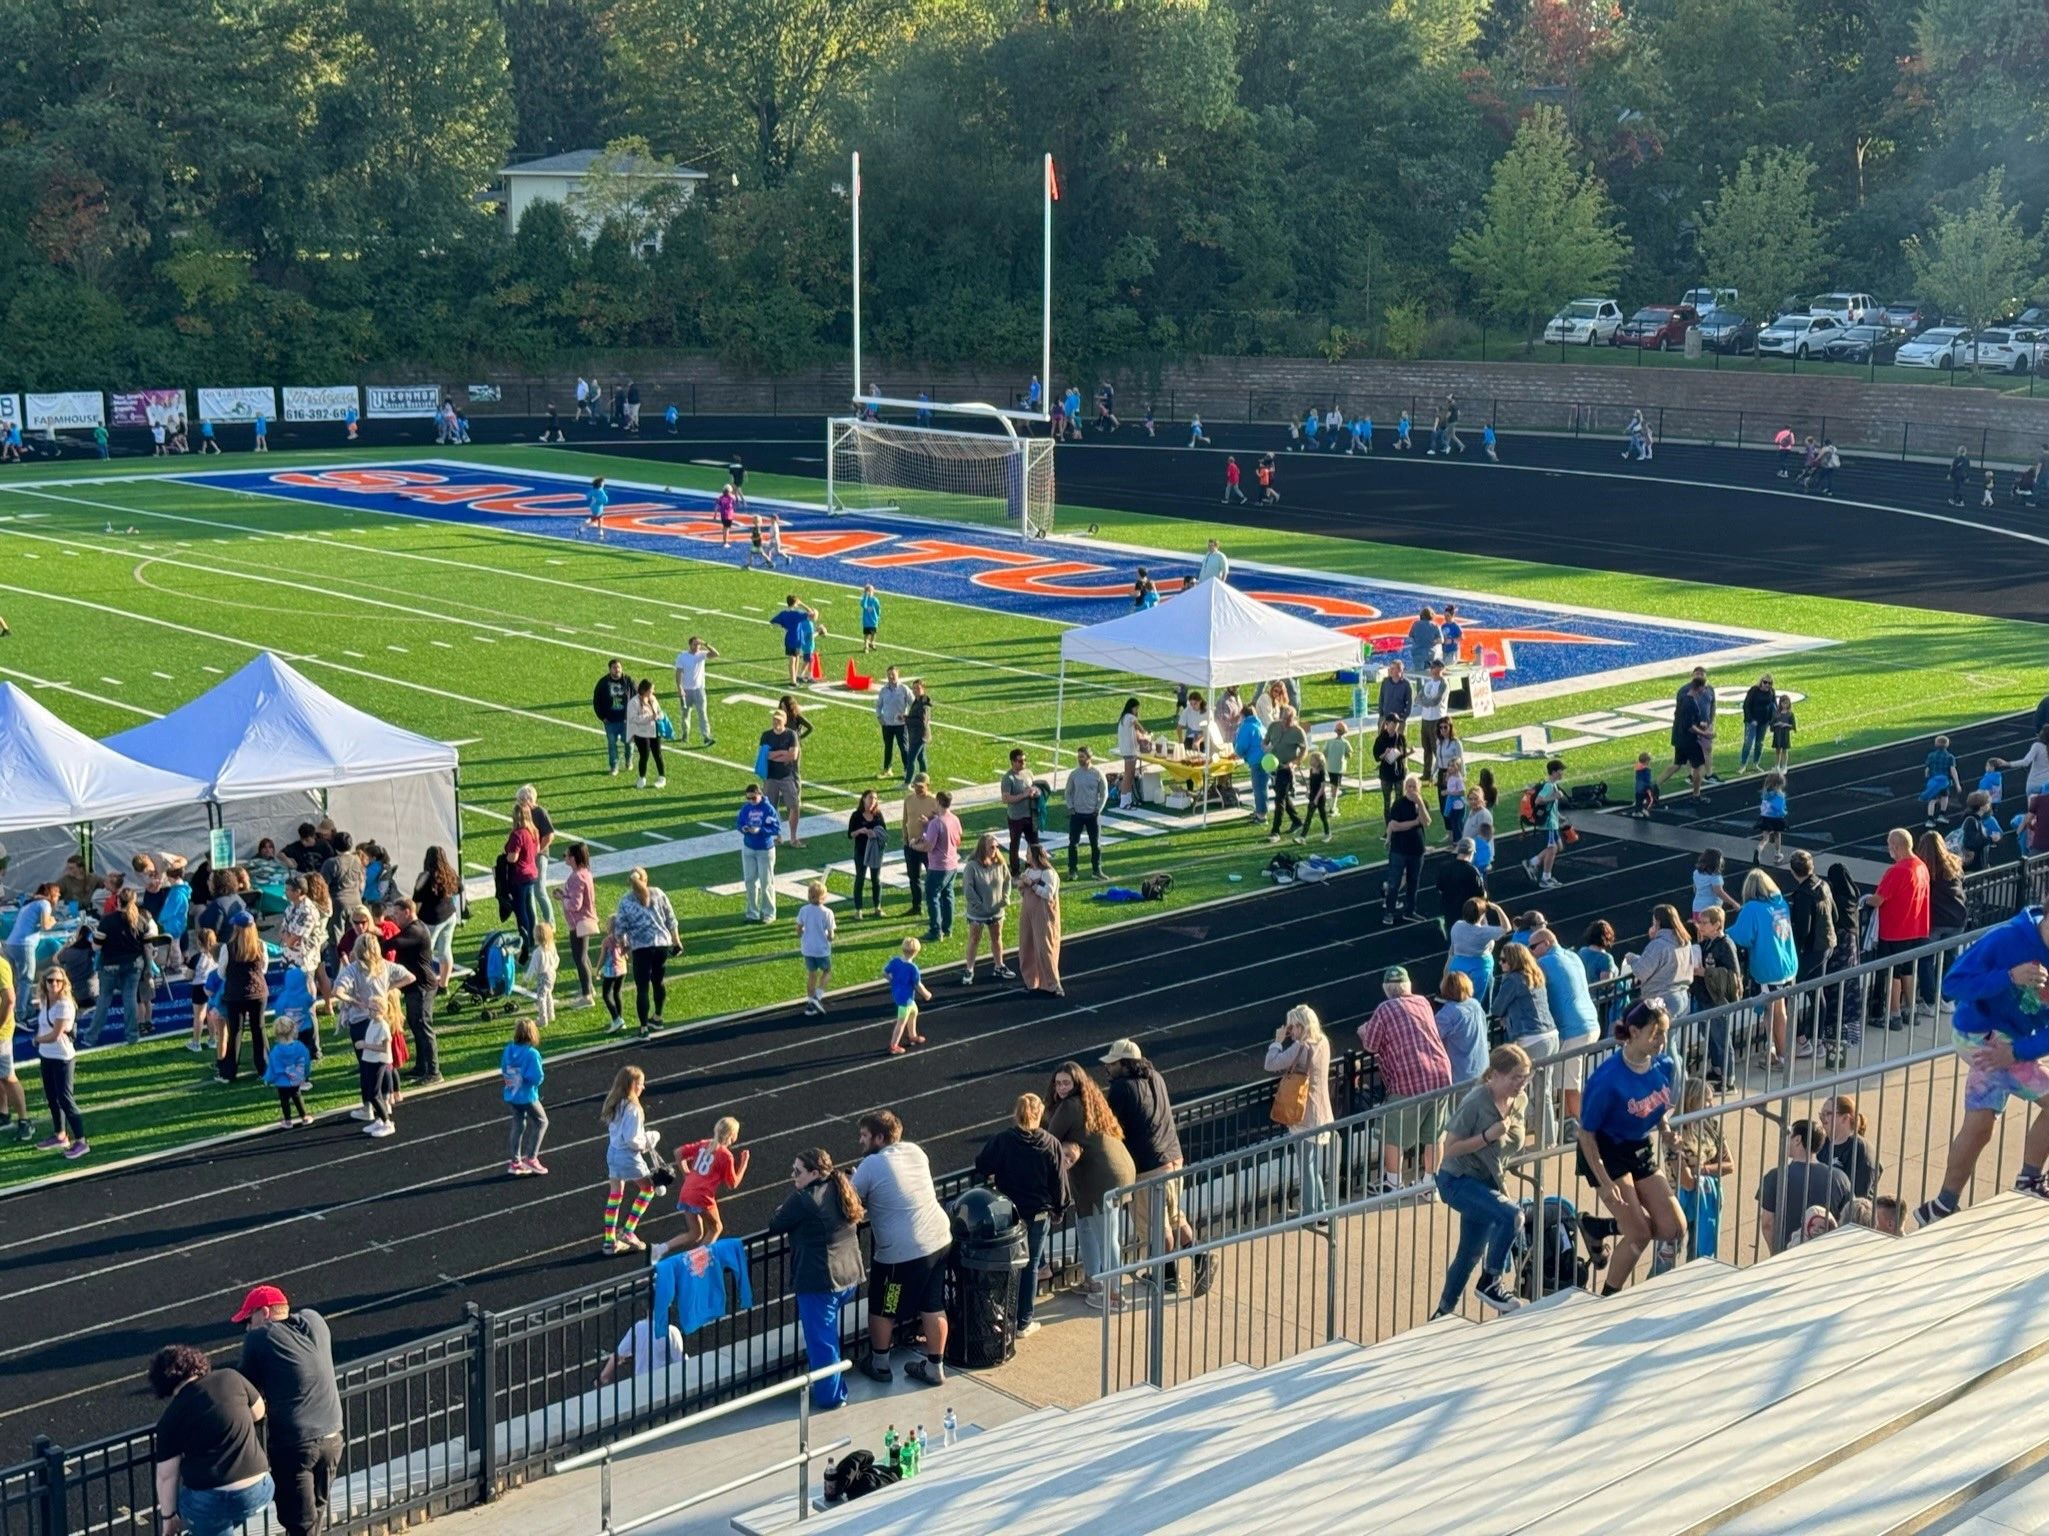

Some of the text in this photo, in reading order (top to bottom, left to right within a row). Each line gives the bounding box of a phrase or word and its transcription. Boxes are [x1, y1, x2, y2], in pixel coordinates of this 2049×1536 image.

[286, 408, 358, 420] 616-392-69
[268, 470, 1638, 672] SAUGATUCK
[693, 1147, 714, 1176] 18
